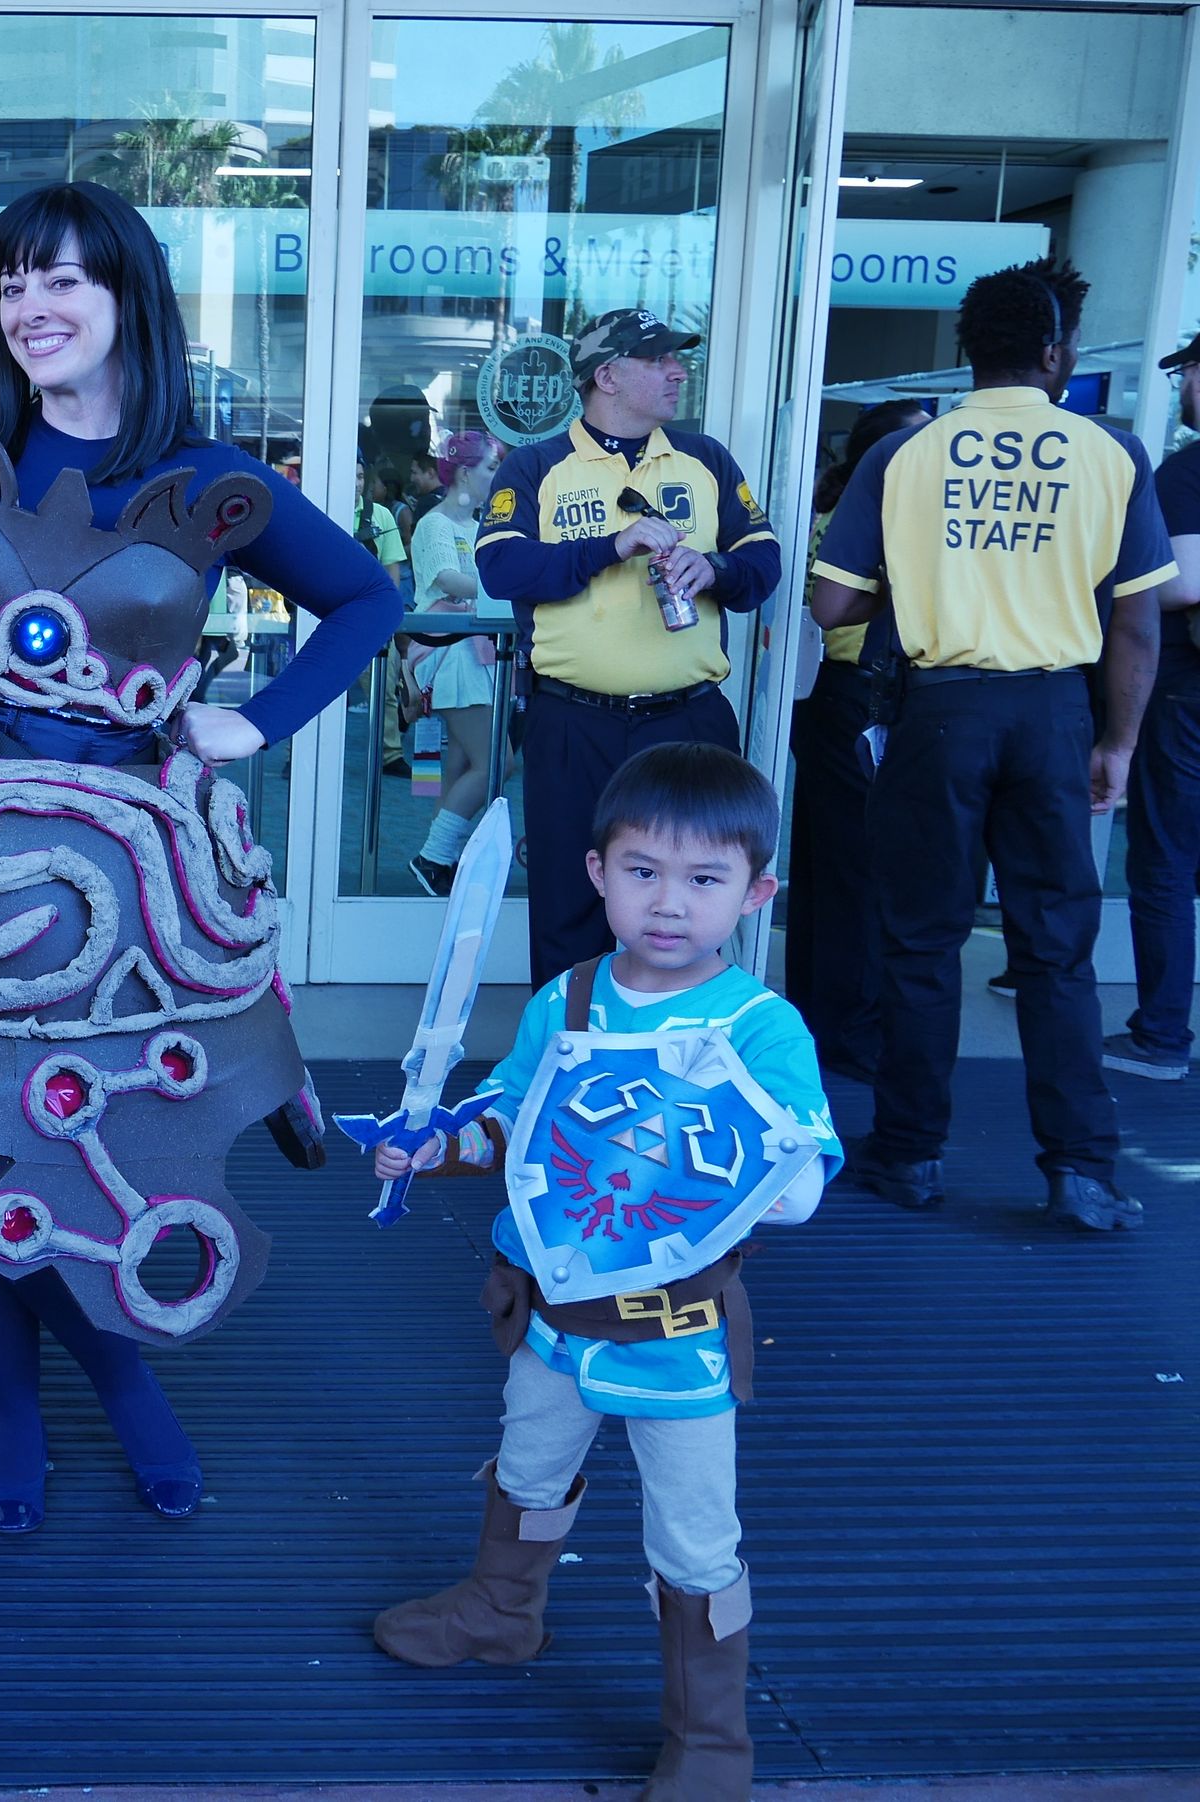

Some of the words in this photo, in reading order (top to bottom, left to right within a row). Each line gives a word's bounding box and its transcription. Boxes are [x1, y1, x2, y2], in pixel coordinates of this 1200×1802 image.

[543, 236, 568, 277] &
[831, 252, 958, 285] ooms
[525, 336, 543, 344] AND
[545, 338, 569, 354] ENVIR
[486, 364, 494, 374] IN
[480, 376, 499, 428] LEADERSHIP
[502, 375, 563, 402] LEED
[950, 430, 1069, 470] CSC
[557, 487, 600, 505] SECURITY
[944, 479, 1070, 513] EVENT
[552, 500, 607, 529] 4016
[561, 524, 605, 540] STAFF
[946, 519, 1055, 553] STAFF
